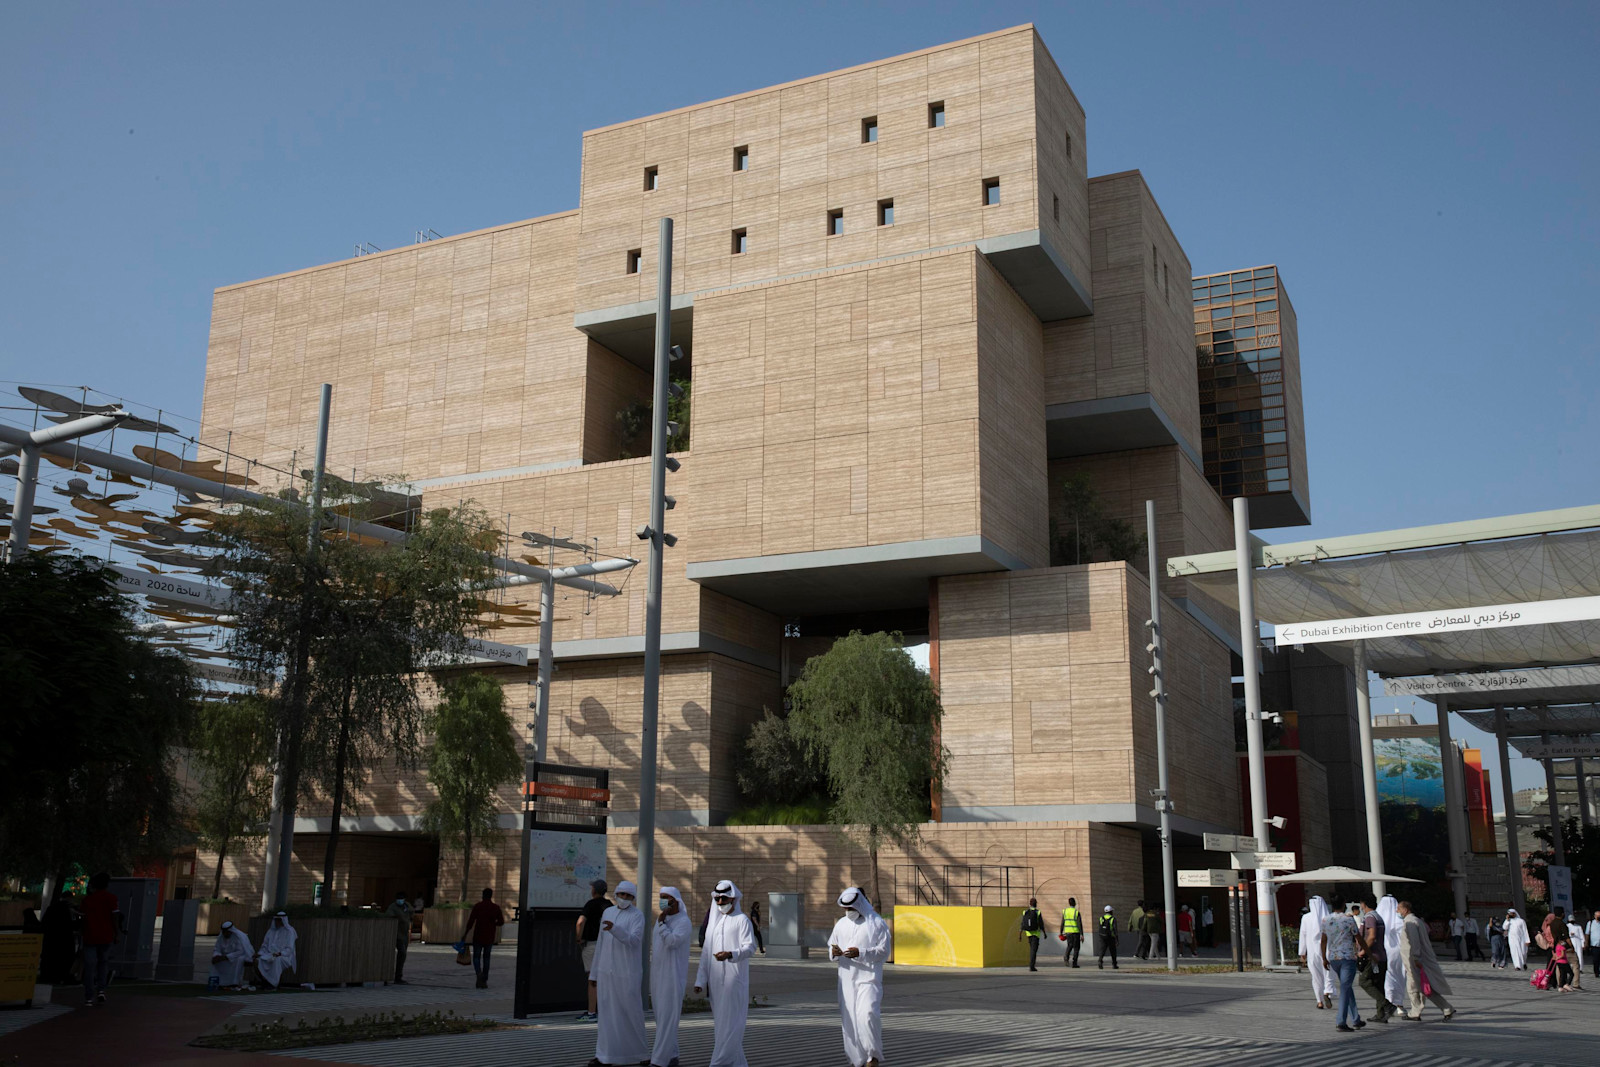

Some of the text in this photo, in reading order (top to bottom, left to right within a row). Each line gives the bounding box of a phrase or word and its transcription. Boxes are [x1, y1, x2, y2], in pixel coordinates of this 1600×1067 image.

[147, 579, 201, 598] ساحة 2020
[1428, 611, 1521, 629] مركز دبي للمعارض
[1300, 620, 1421, 638] Dubai Exhibition Centre
[486, 648, 499, 658] دبي
[499, 648, 512, 659] مركز
[1407, 682, 1434, 691] Visitor
[1436, 680, 1466, 689] Centre
[1509, 676, 1528, 685] مركز
